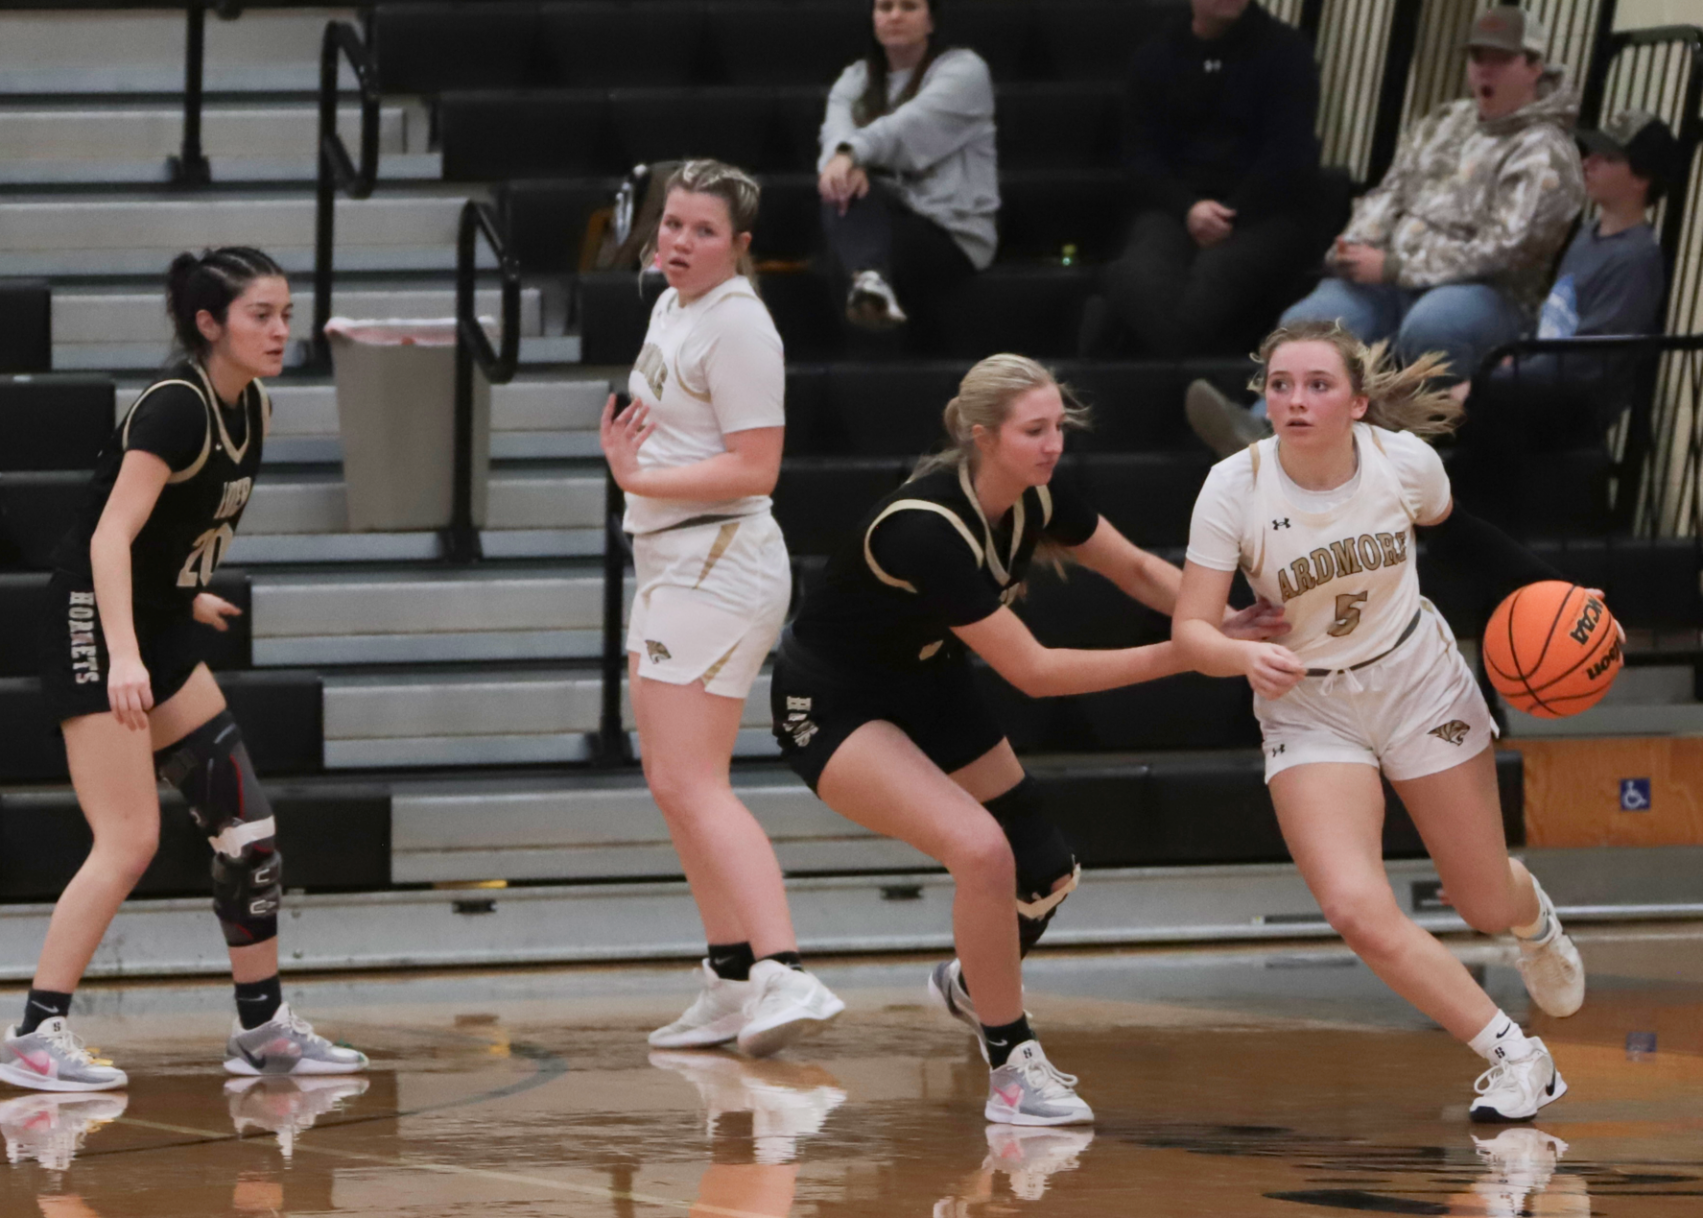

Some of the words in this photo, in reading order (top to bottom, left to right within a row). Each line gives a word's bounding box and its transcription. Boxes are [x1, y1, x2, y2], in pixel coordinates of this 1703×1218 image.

[176, 522, 233, 587] 20
[1278, 531, 1407, 603] ARDMORE
[1327, 590, 1368, 637] 5
